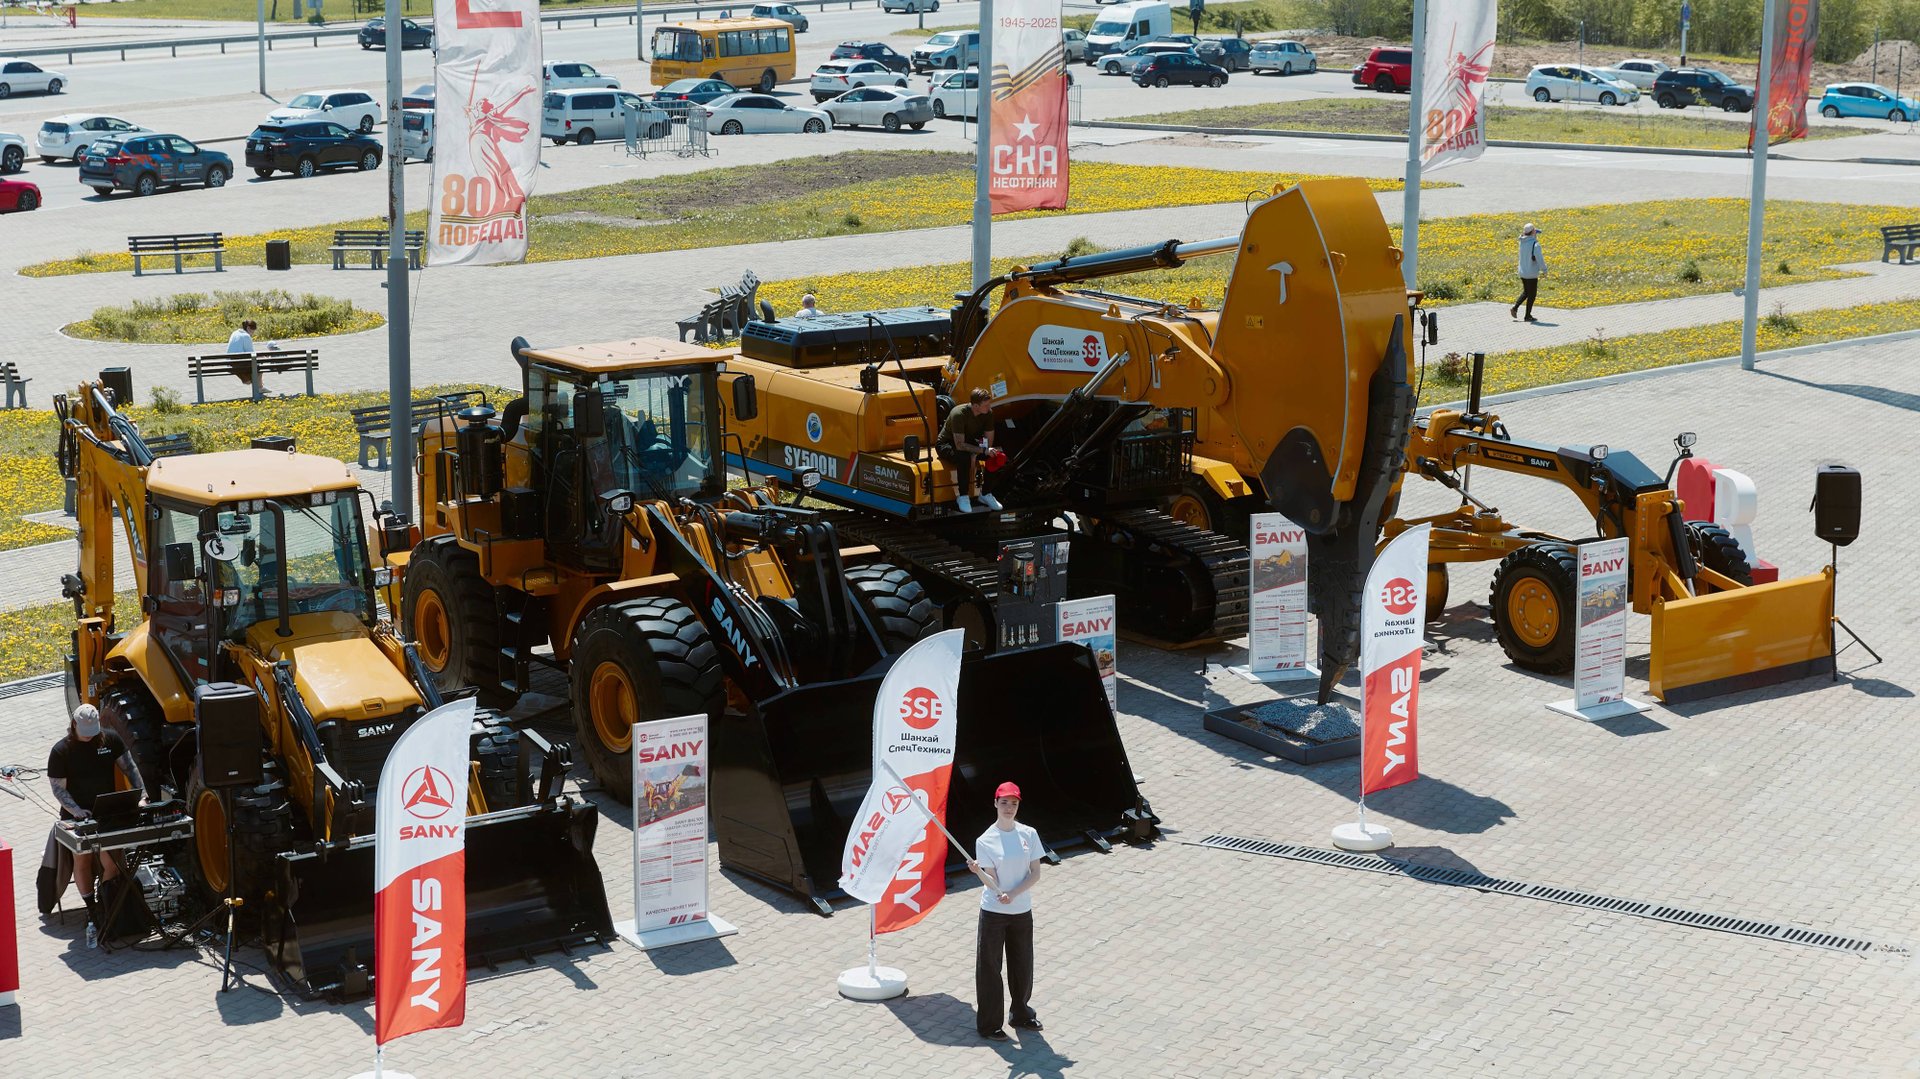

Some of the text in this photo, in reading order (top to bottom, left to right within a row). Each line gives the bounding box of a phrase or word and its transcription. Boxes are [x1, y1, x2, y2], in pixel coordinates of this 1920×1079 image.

[993, 144, 1058, 175] СКА
[993, 177, 1057, 188] НЕФТЯНИК
[441, 173, 491, 217] 80
[438, 218, 524, 247] ПОБЕДА!
[1041, 337, 1065, 345] Шанхай
[1042, 347, 1080, 357] СпецТехника
[784, 445, 837, 479] SY500H
[1530, 458, 1550, 467] SANY
[874, 465, 900, 478] SANY
[1255, 530, 1305, 545] SANY
[1582, 557, 1625, 577] SANY
[711, 597, 758, 667] SANY
[1062, 617, 1112, 637] SANY
[358, 723, 394, 738] SANY
[901, 733, 939, 743] Шанхай
[639, 739, 704, 763] SANY
[888, 743, 951, 754] СпецТехника
[399, 825, 459, 840] SANY
[411, 878, 442, 1013] SANY
